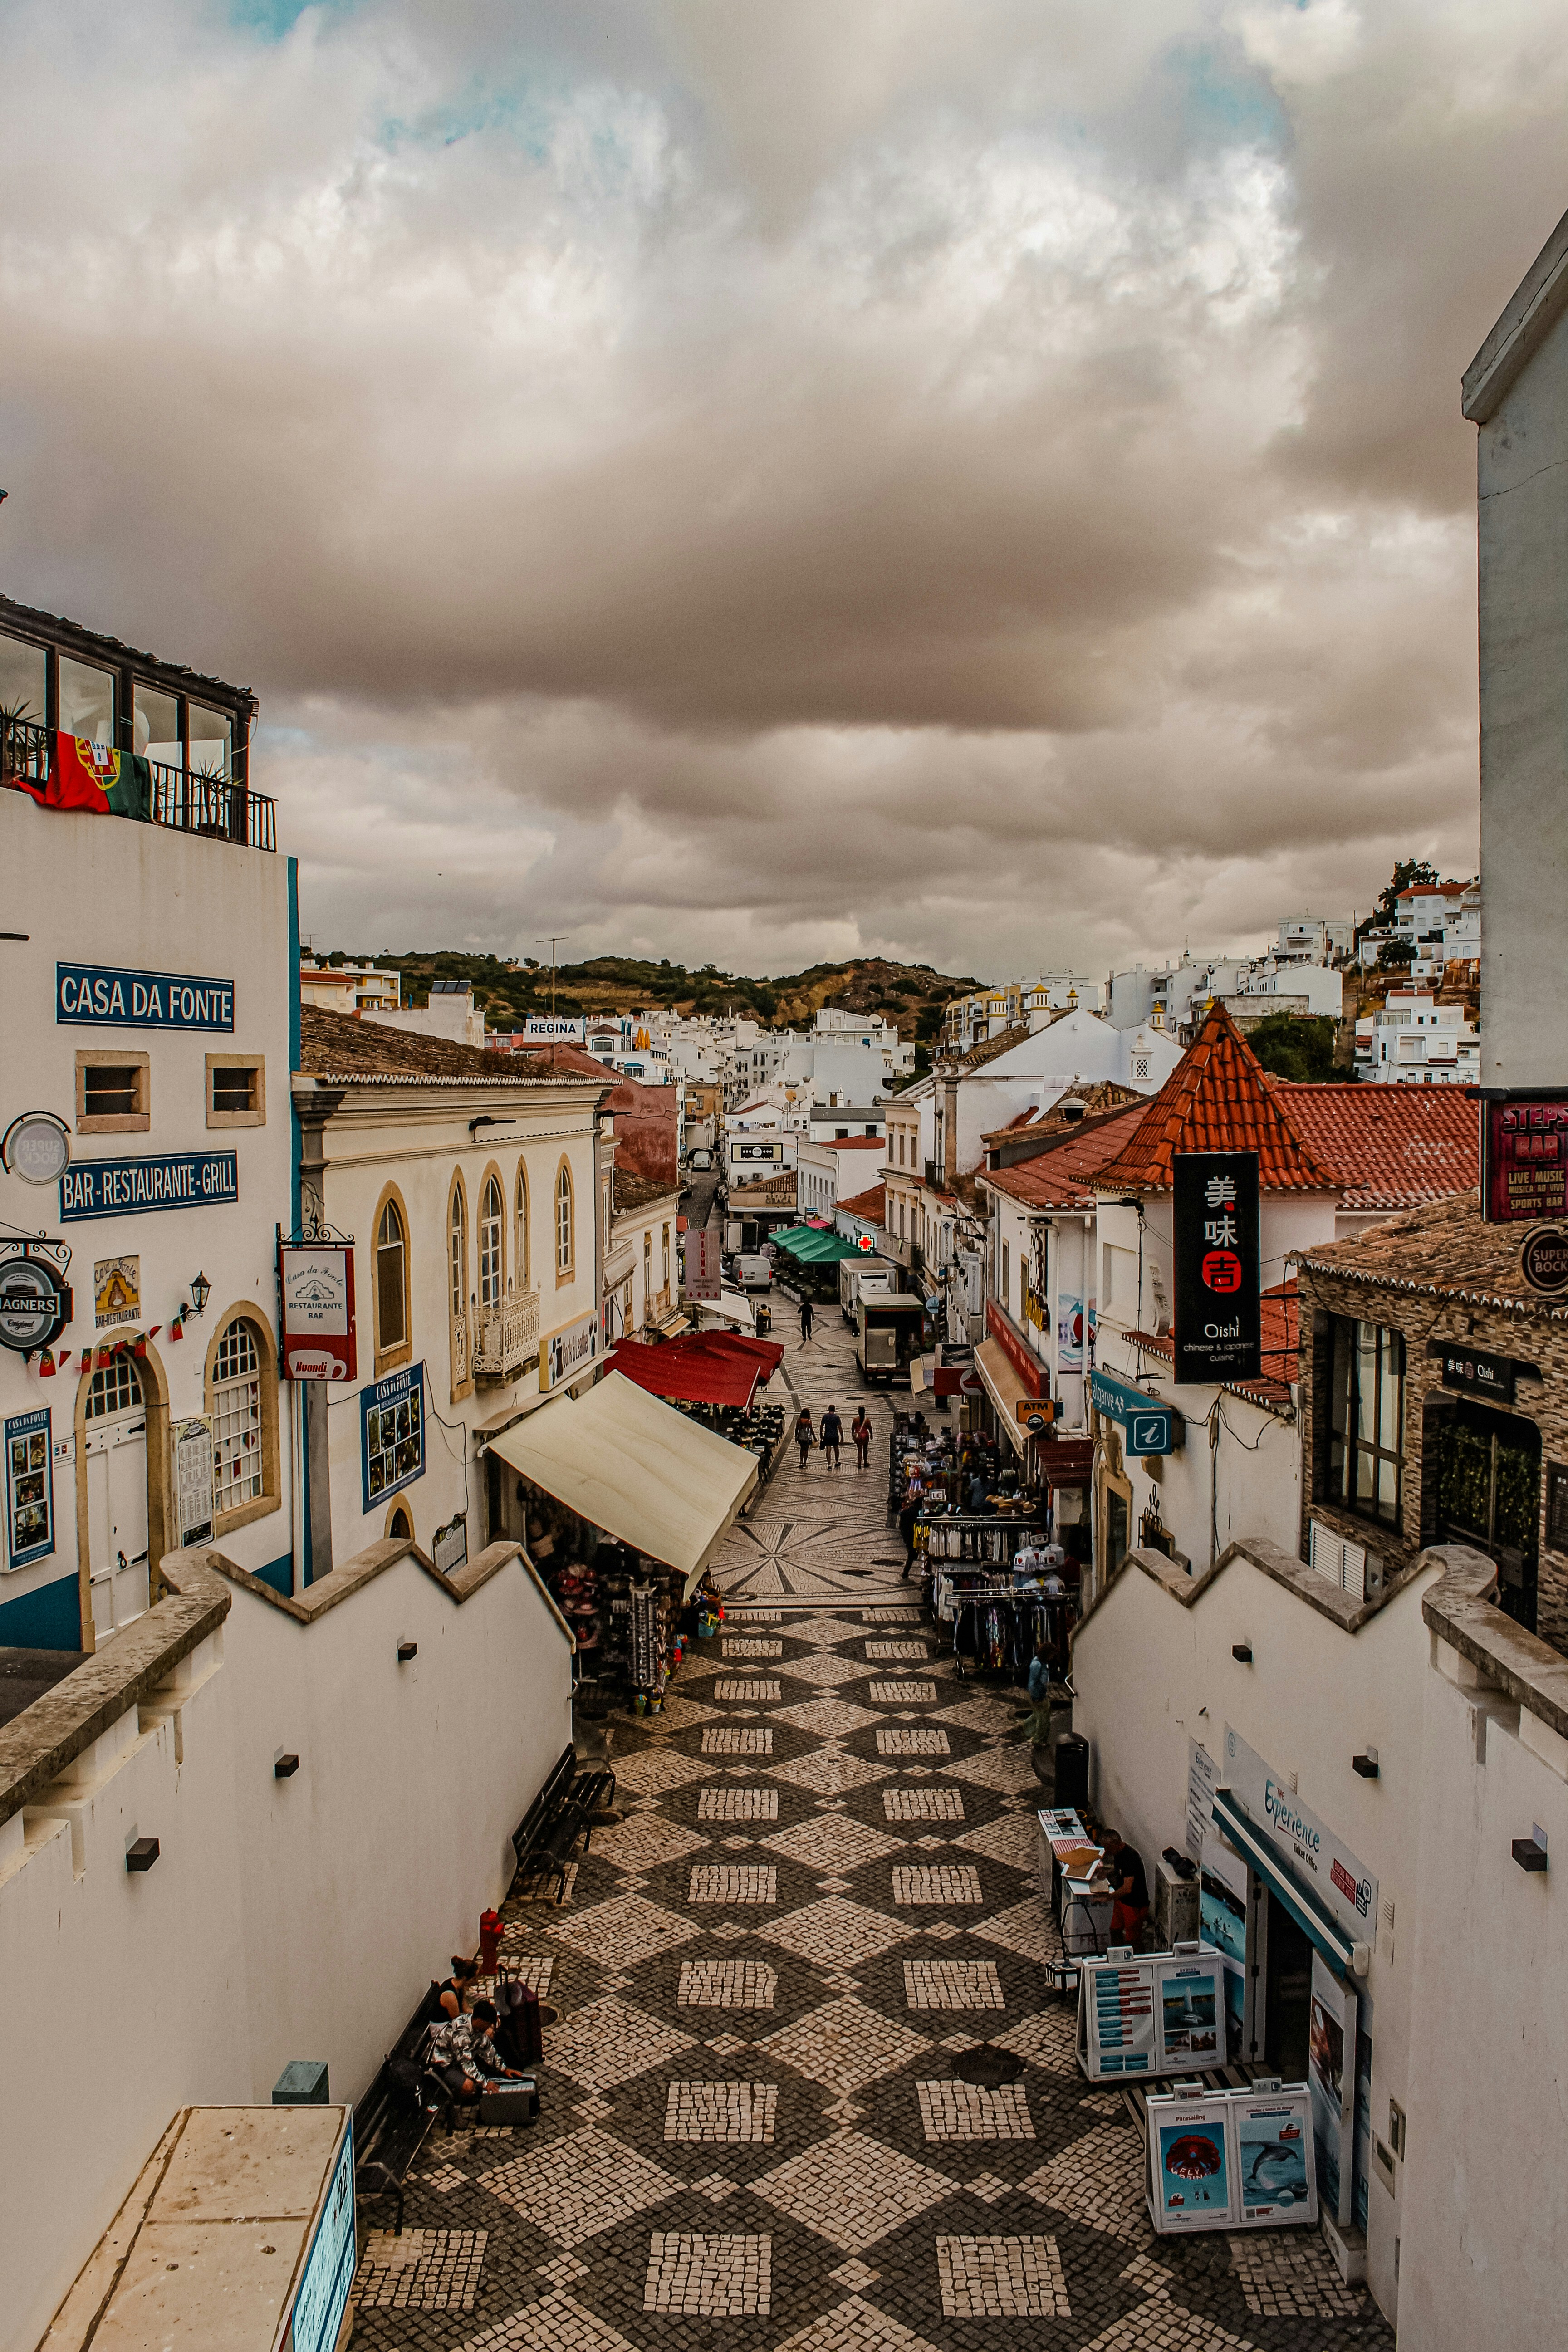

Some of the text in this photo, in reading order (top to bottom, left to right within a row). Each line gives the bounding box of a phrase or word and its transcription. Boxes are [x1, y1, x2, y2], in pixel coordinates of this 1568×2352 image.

[61, 976, 232, 1023] CASA DA FONTE
[530, 1023, 576, 1034] REGINA
[1503, 1102, 1568, 1130] STEPS
[1515, 1135, 1558, 1162] BAR
[1509, 1170, 1565, 1184] LIVE MUSIC
[1537, 1184, 1546, 1192] AO
[1550, 1183, 1564, 1191] VIVO
[1511, 1197, 1563, 1209] SPORTS BAR
[1533, 1249, 1568, 1261] SUPER
[1535, 1261, 1568, 1273] BOCK
[285, 1265, 344, 1289] Casa da Fonte
[0, 1298, 55, 1312] AGNERS
[8, 1318, 35, 1330] Original
[1205, 1318, 1239, 1338] Oishi
[563, 1338, 572, 1369] Cork
[575, 1329, 589, 1361] Leather
[1184, 1343, 1214, 1352] chinese
[1224, 1341, 1254, 1352] japanese
[1210, 1353, 1235, 1362] cuisine
[295, 1361, 327, 1373] Buondi
[1477, 1364, 1494, 1380] Oishi
[377, 1370, 411, 1401] CASA DA FONTE
[1093, 1379, 1115, 1411] algarve
[1023, 1402, 1048, 1411] ATM
[8, 1411, 48, 1430] CASA DA FONTE
[1277, 1787, 1285, 1801] THE
[1264, 1778, 1320, 1854] Experience
[1293, 1842, 1318, 1874] Ticket Office
[1334, 1860, 1355, 1890] BOOK HERE
[1179, 2167, 1199, 2176] FLY
